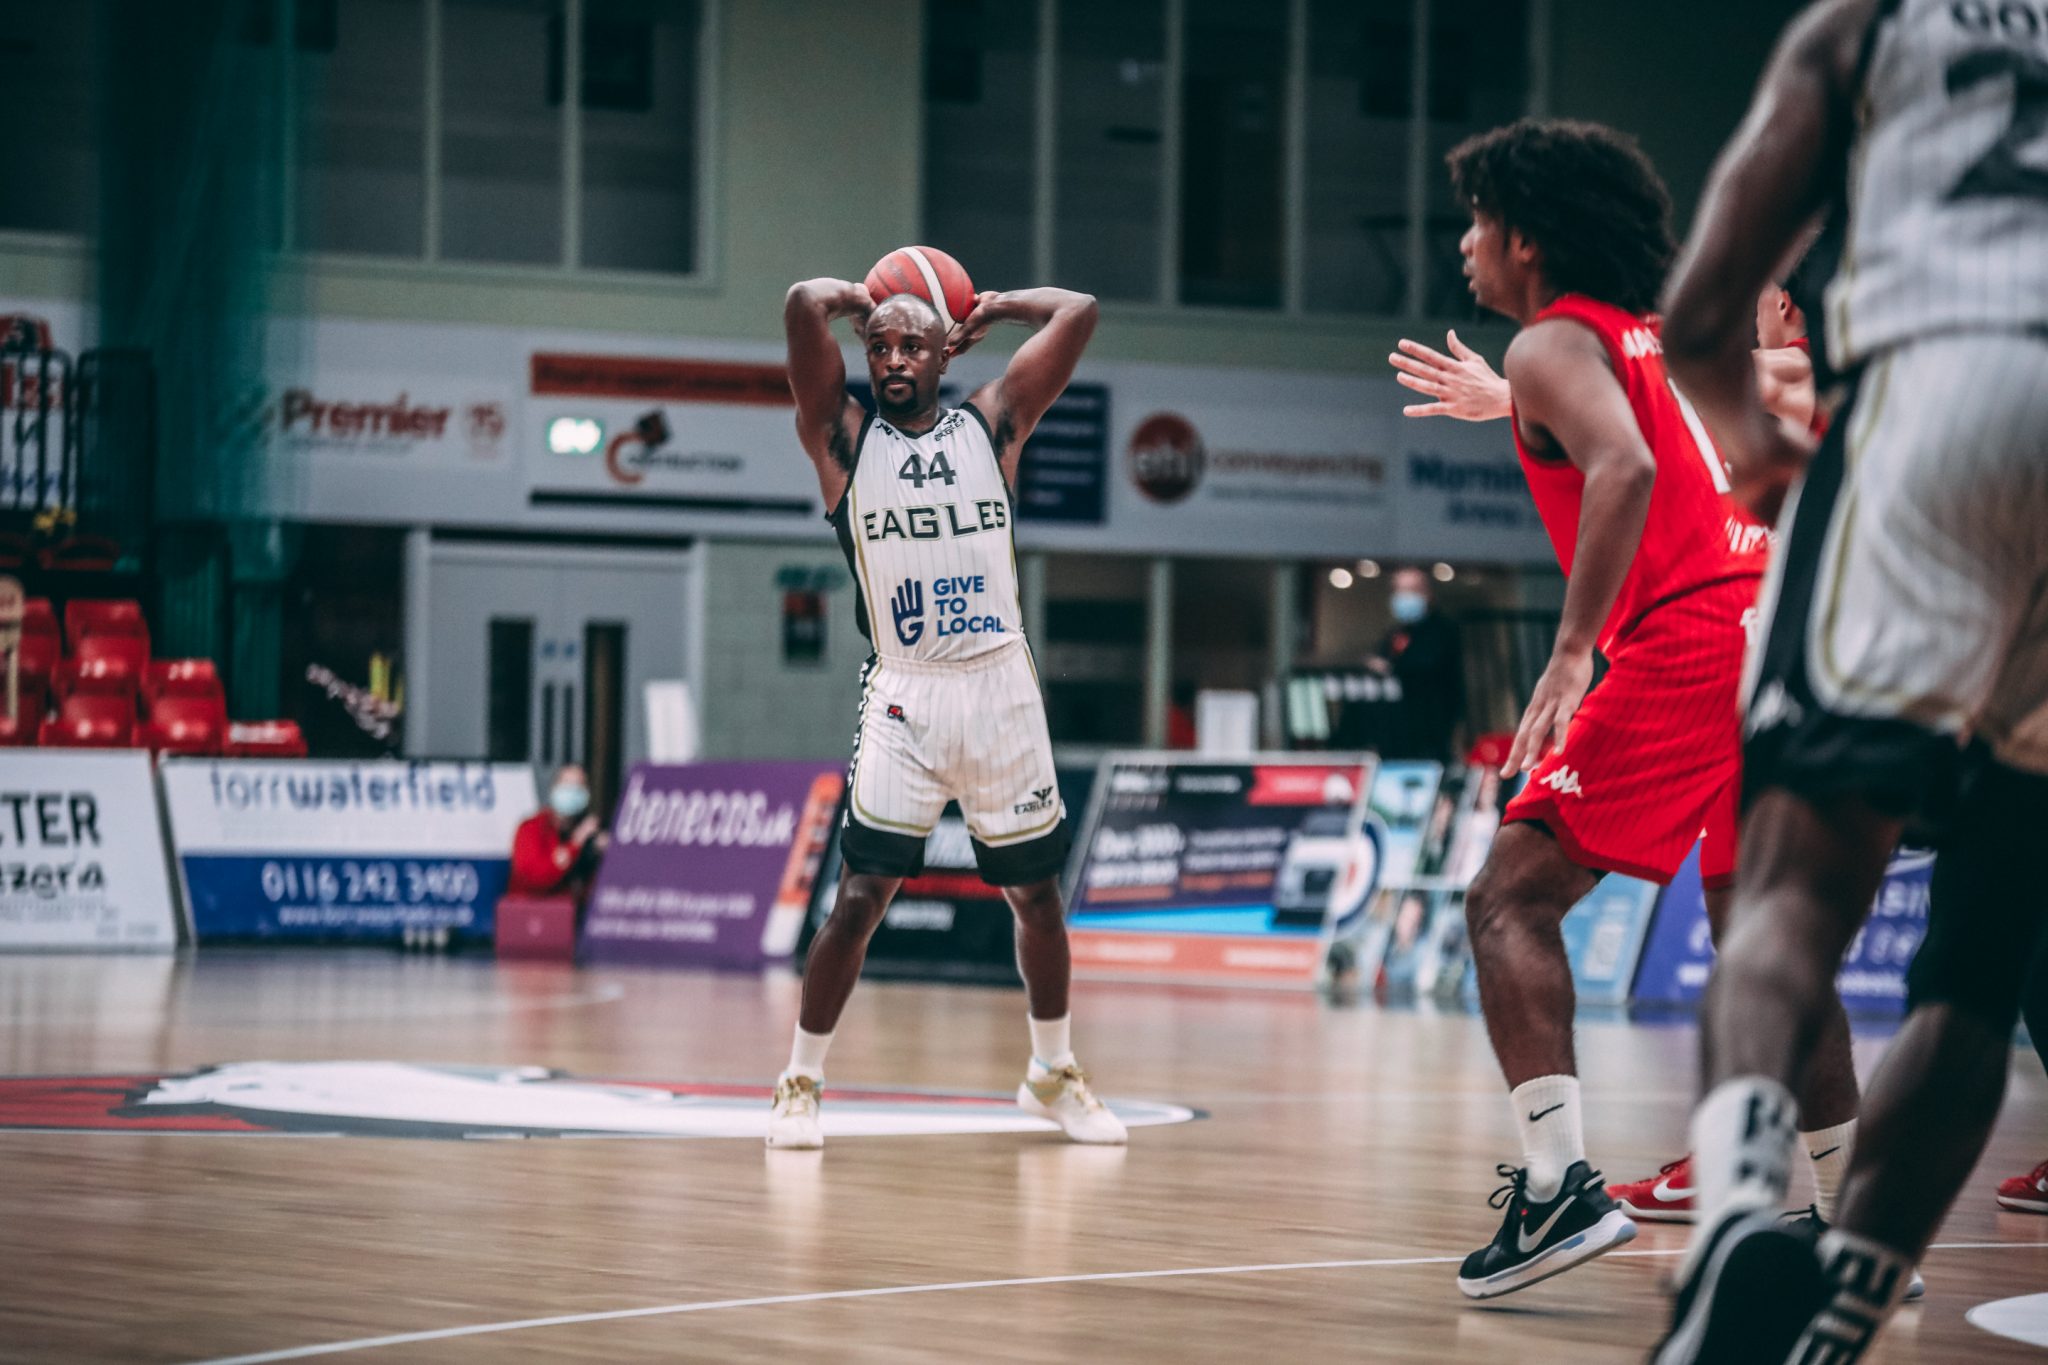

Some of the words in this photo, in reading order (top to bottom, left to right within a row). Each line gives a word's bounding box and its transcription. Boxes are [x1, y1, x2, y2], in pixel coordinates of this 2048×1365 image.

[282, 387, 450, 438] Premier
[898, 451, 957, 488] 44
[863, 500, 1007, 542] EAGLES
[932, 576, 985, 596] GIVE
[934, 598, 968, 616] TO
[937, 616, 1006, 637] LOCAL
[0, 790, 102, 845] TER
[261, 861, 340, 902] 0116
